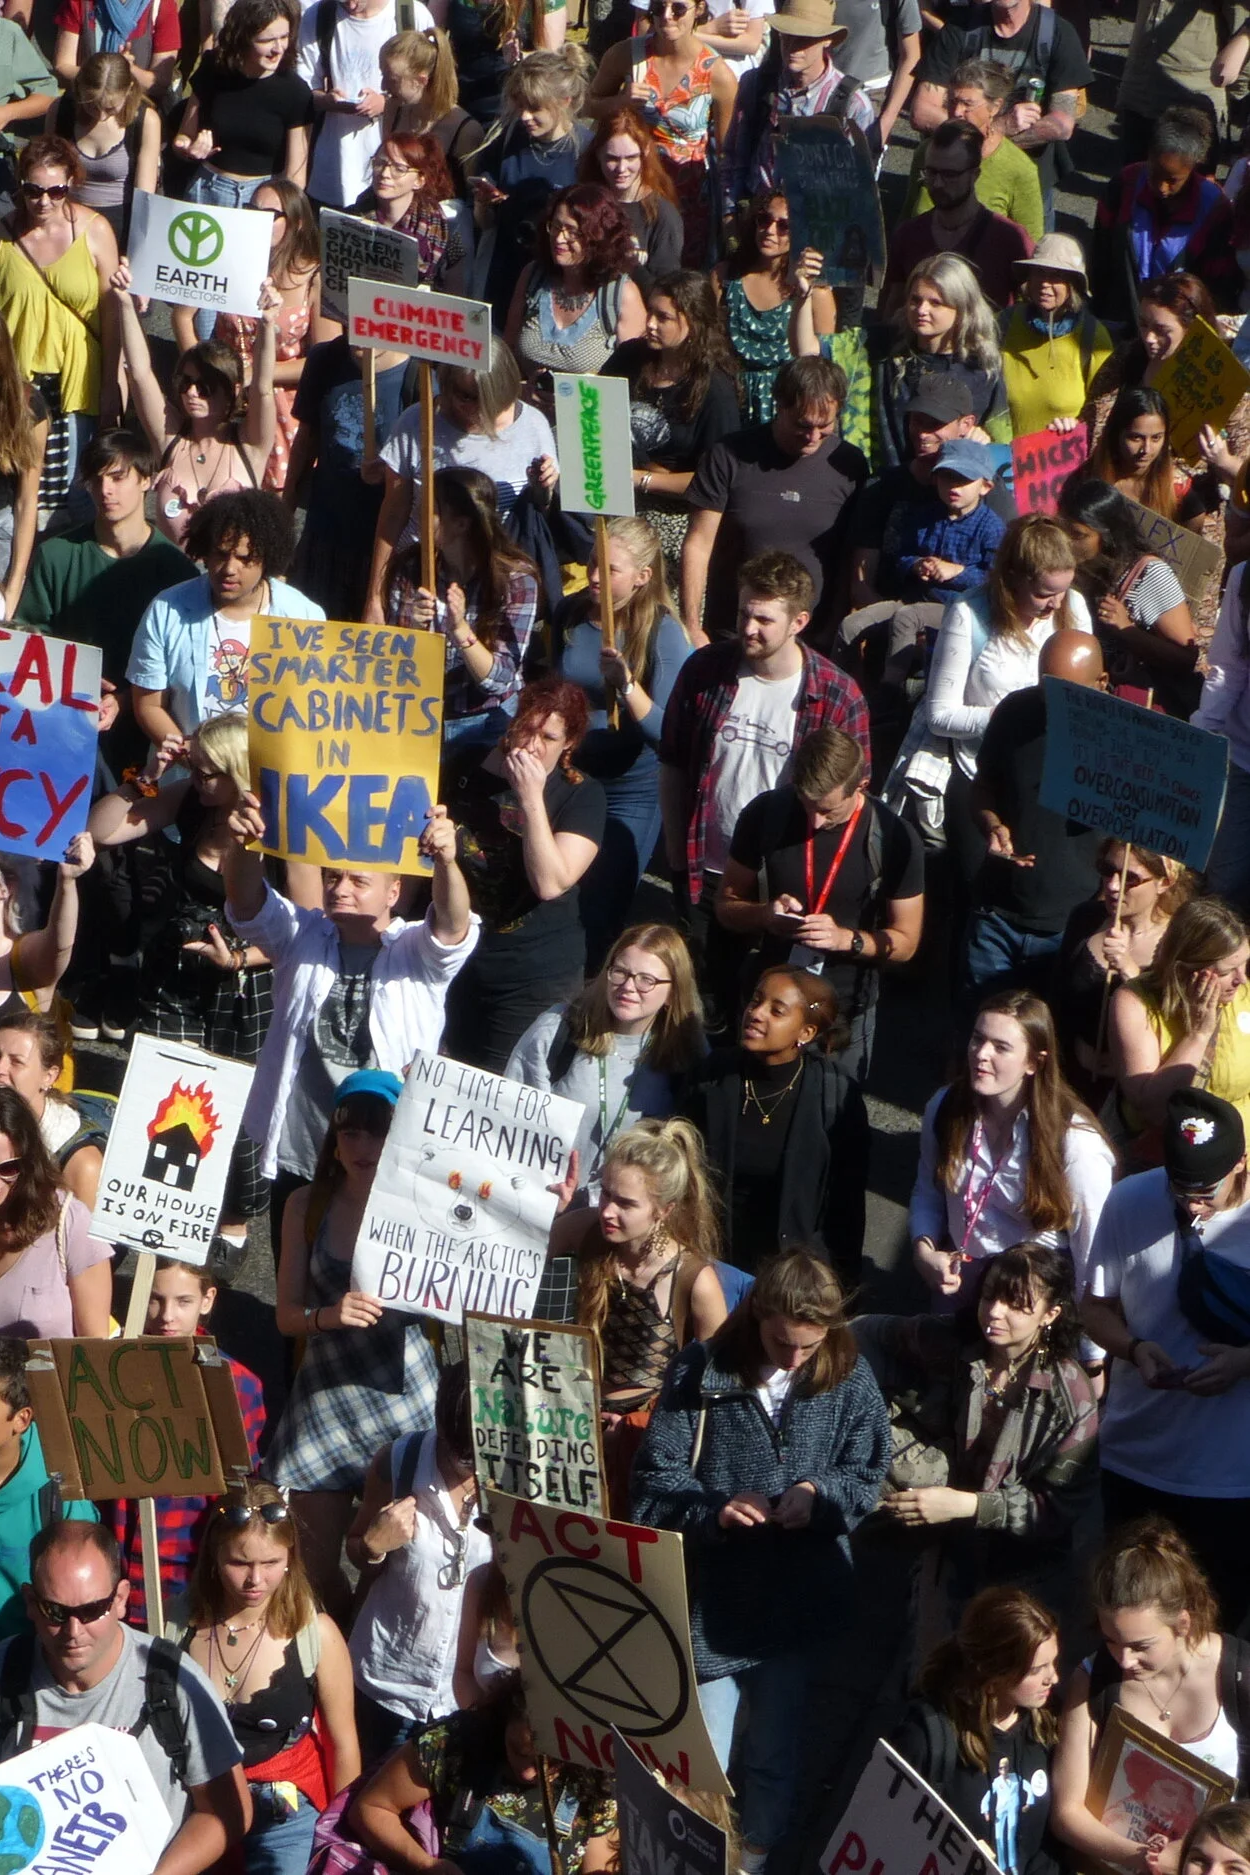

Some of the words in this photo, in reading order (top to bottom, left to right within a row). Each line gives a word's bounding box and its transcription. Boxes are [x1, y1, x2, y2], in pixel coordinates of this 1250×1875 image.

[326, 226, 401, 260] SYSTEM
[326, 241, 405, 274] CHANGE
[326, 252, 363, 274] NOT
[154, 283, 227, 305] PROTECTORS
[156, 264, 228, 293] EARTH
[373, 297, 465, 332] CLIMATE
[354, 317, 483, 360] EMERGENCY
[268, 622, 324, 651] I'VE
[336, 627, 417, 658] SEEN
[250, 652, 421, 688] SMARTER
[11, 708, 37, 745] A
[252, 689, 440, 737] CABINETS
[316, 738, 350, 769] IN
[259, 767, 436, 870] IKEA
[1073, 765, 1202, 829] OVERCONSUMPTION
[1113, 801, 1140, 820] NOT
[1067, 797, 1190, 860] OVERPOPULATION
[416, 1057, 446, 1088] NO
[457, 1066, 507, 1111] TIME
[514, 1086, 551, 1127] FOR
[423, 1098, 565, 1176] LEARNING
[101, 1197, 126, 1216] IS
[133, 1209, 163, 1225] ON
[169, 1219, 212, 1242] FIRE
[107, 1179, 147, 1203] OUR
[155, 1191, 217, 1223] HOUSE
[368, 1216, 417, 1254] WHEN
[425, 1230, 458, 1264] THE
[462, 1241, 541, 1280] ARCTIC'S
[378, 1251, 530, 1320] BURNING
[502, 1329, 552, 1364] WE
[67, 1343, 189, 1413] ACT
[490, 1358, 561, 1394] ARE
[71, 1413, 211, 1486] NOW
[475, 1428, 595, 1466] DEFENDING
[479, 1452, 597, 1507] ITSELF
[509, 1500, 659, 1584] ACT
[28, 1746, 96, 1792] THERE'S
[53, 1770, 104, 1811] NO
